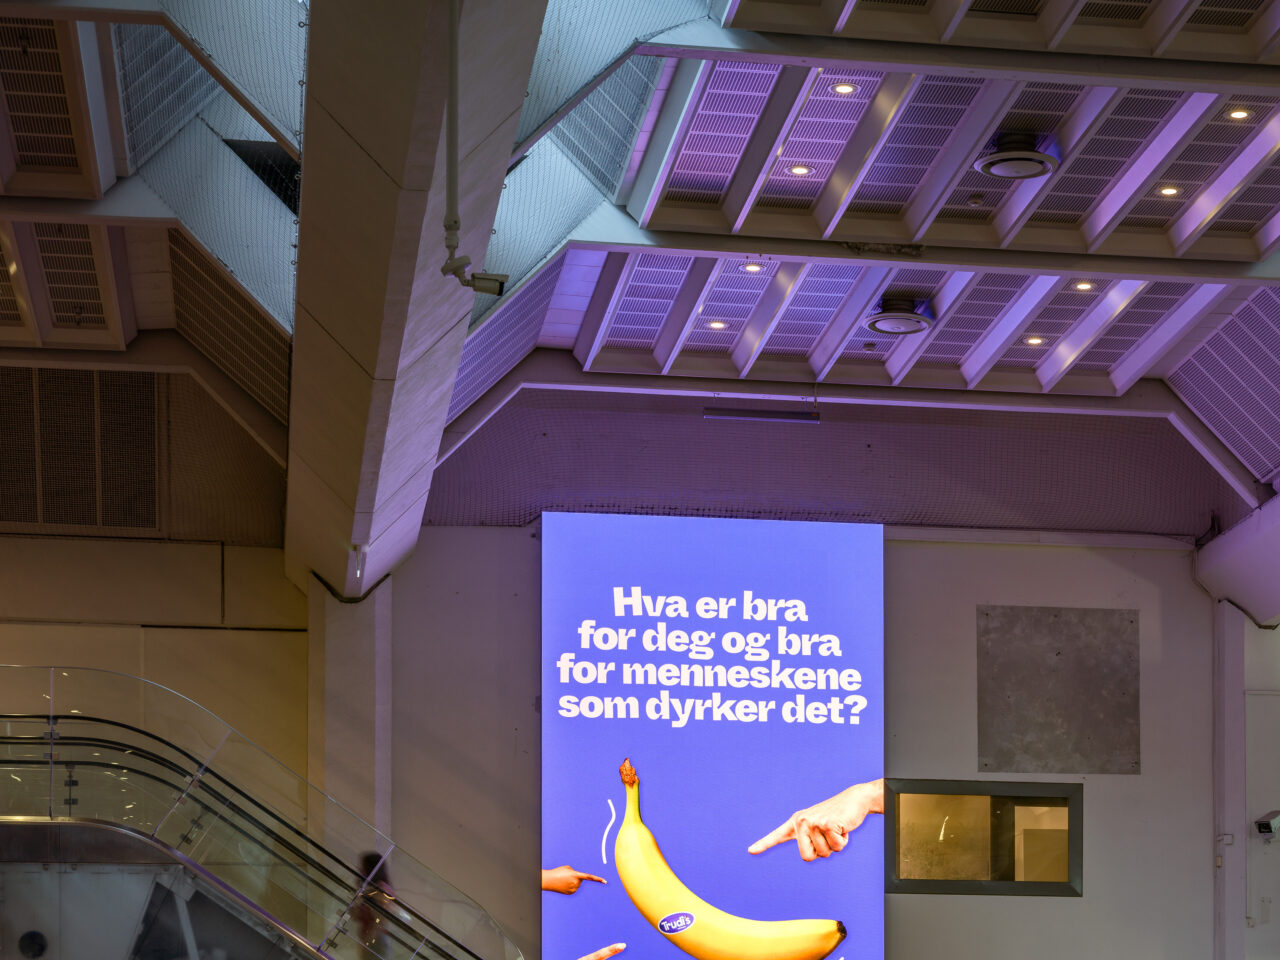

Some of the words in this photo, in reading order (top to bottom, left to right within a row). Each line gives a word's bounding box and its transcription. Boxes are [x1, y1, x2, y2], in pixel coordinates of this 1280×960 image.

[613, 586, 689, 618] Hva
[695, 596, 737, 619] er
[743, 590, 808, 622] bra
[577, 619, 636, 650] for
[642, 622, 716, 660] deg
[721, 631, 771, 662] og
[777, 626, 843, 657] bra
[556, 652, 616, 684] for
[622, 659, 862, 691] menneskene
[558, 695, 640, 719] som
[645, 690, 776, 728] dyrker
[781, 694, 868, 725] det?
